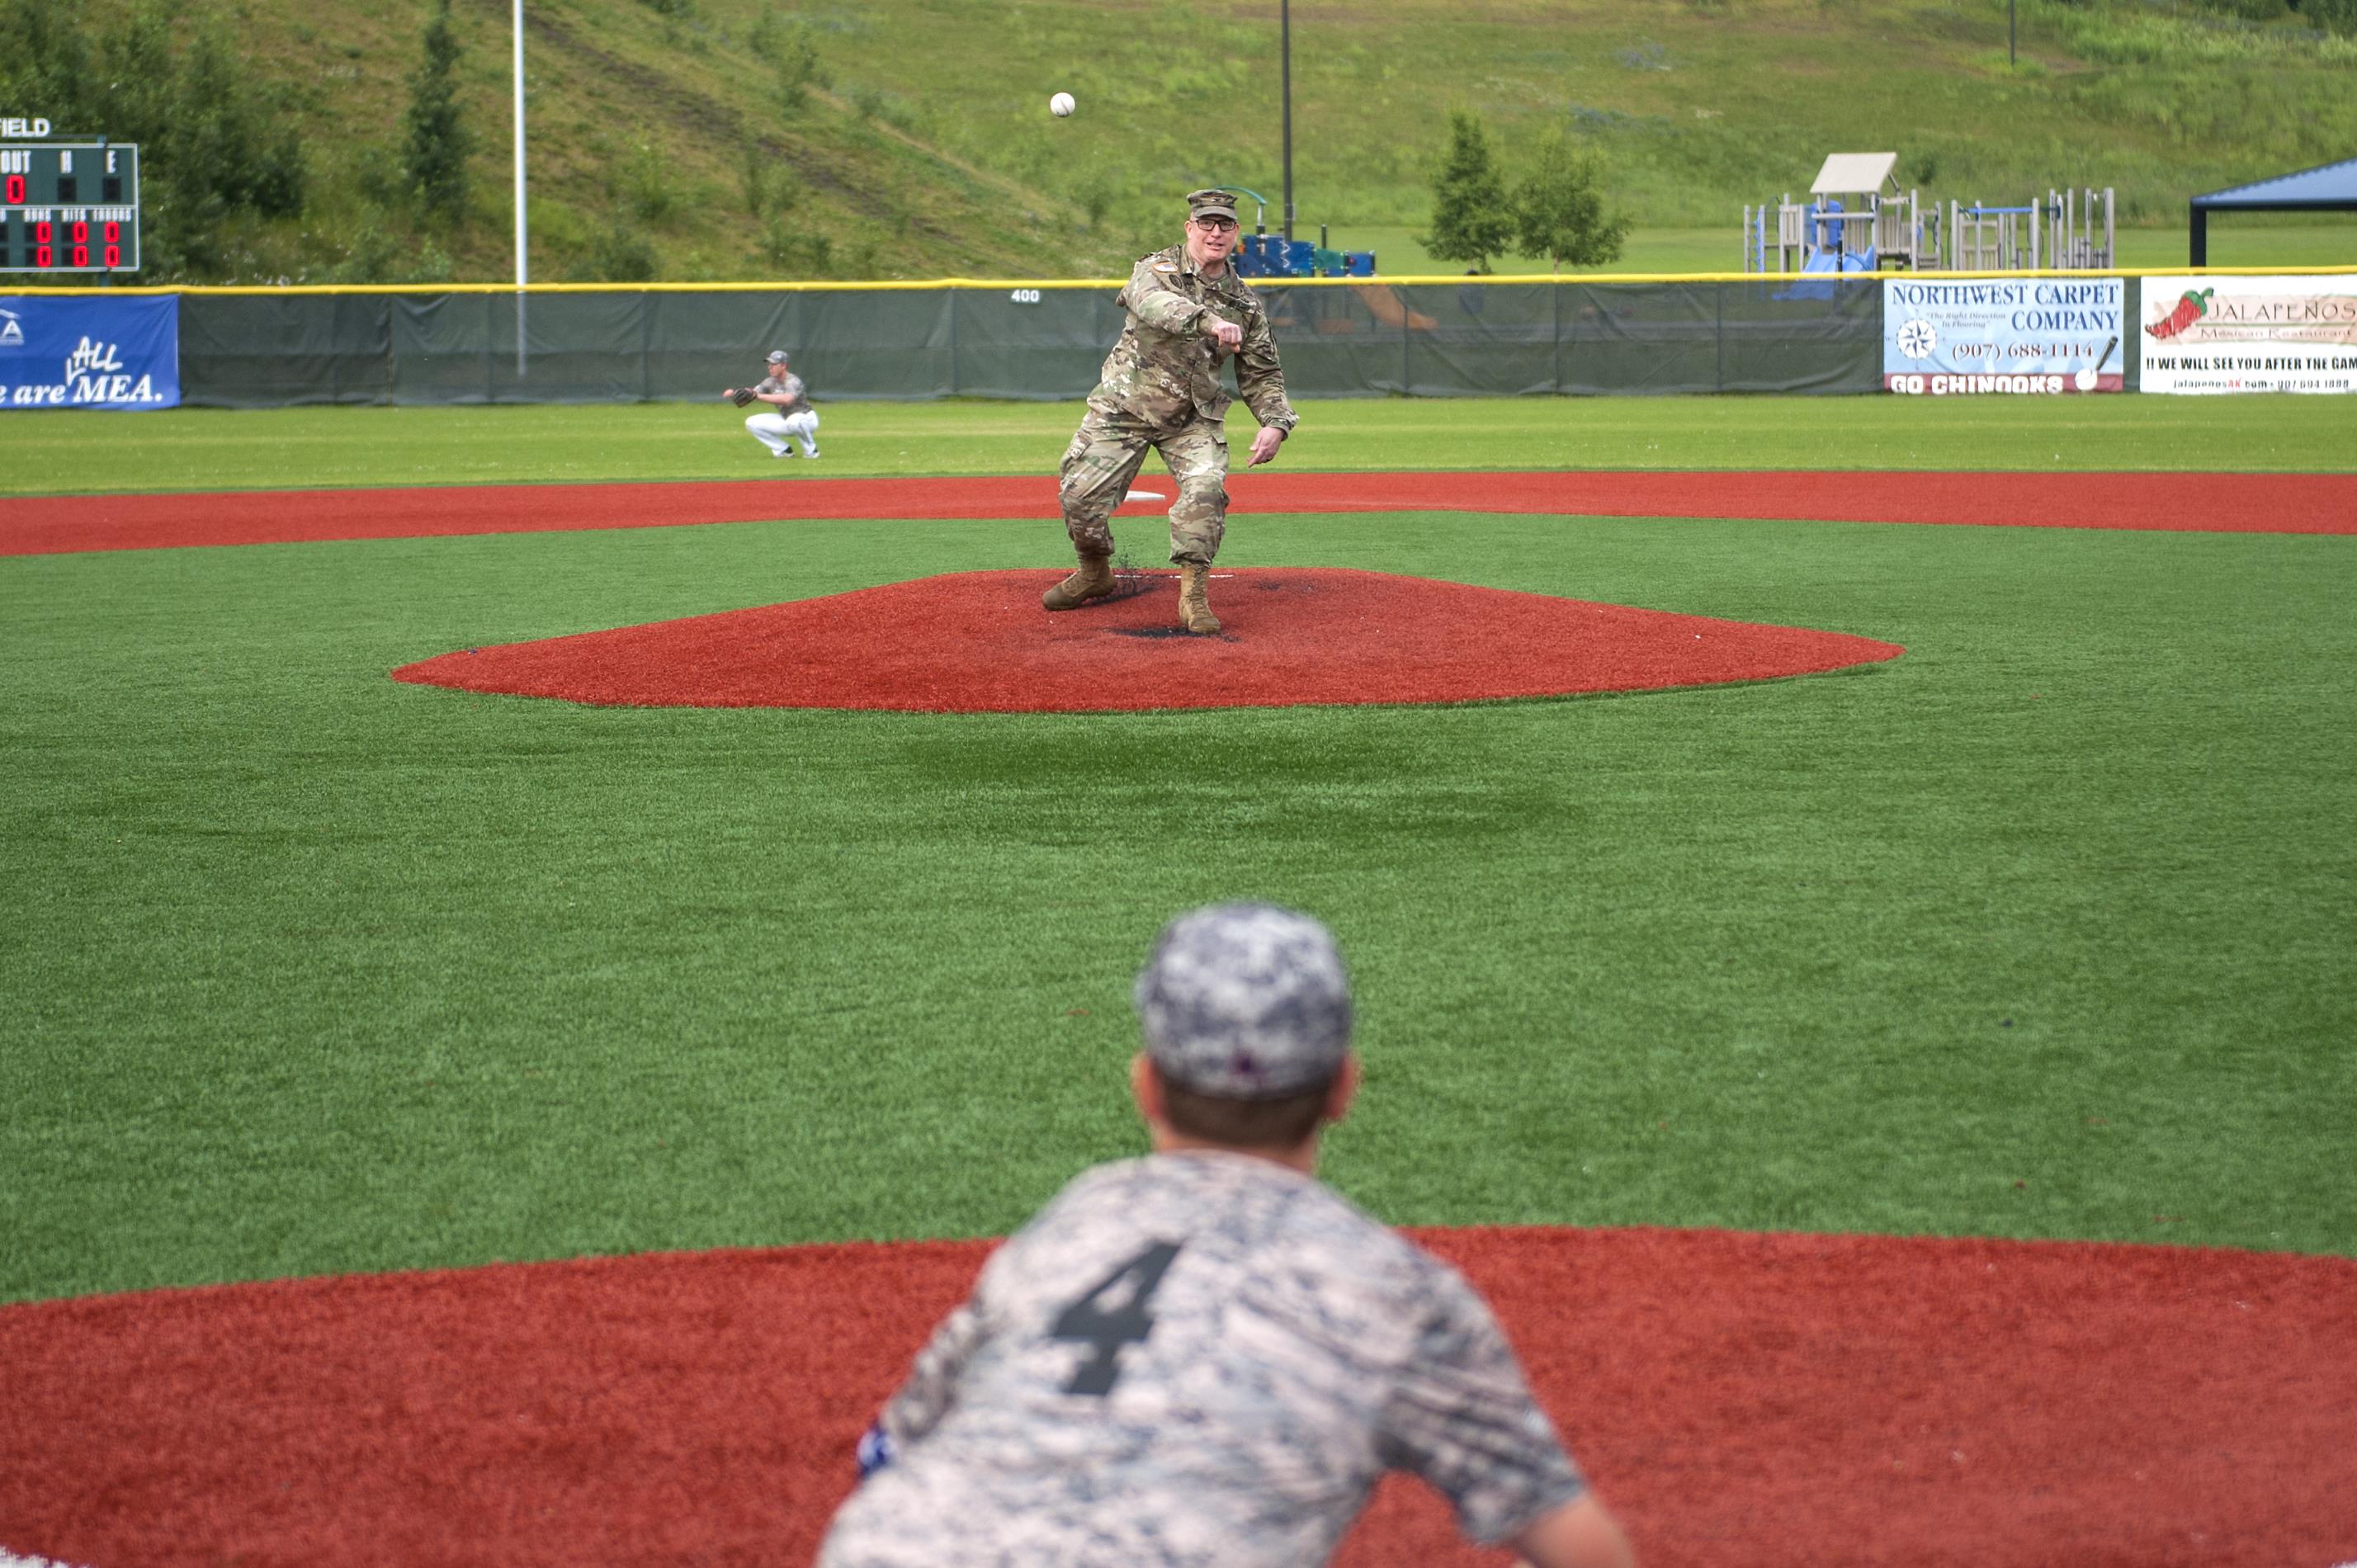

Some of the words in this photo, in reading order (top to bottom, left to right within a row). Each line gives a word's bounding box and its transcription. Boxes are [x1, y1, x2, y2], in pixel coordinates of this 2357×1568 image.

[0, 117, 50, 138] IELD
[0, 149, 31, 174] OUT
[60, 149, 73, 174] H
[106, 149, 116, 174] E
[6, 174, 26, 205] 0
[1011, 289, 1040, 302] 400
[1892, 284, 2029, 305] NORTHWEST
[2034, 283, 2118, 305] CARPET
[2011, 310, 2118, 331] COMPANY
[73, 336, 123, 371] ALL
[1953, 342, 2001, 361] (907)
[2008, 342, 2094, 357] 688-1114
[2158, 357, 2177, 370] WE
[2180, 357, 2209, 370] WILL
[2213, 357, 2234, 370] SEE
[2237, 357, 2261, 370] YOU
[2265, 357, 2302, 370] AFTER
[2306, 357, 2327, 370] THE
[14, 384, 66, 404] are
[1890, 375, 1924, 394] GO
[1931, 375, 2063, 394] CHINOOKS
[1048, 1239, 1183, 1396] 4
